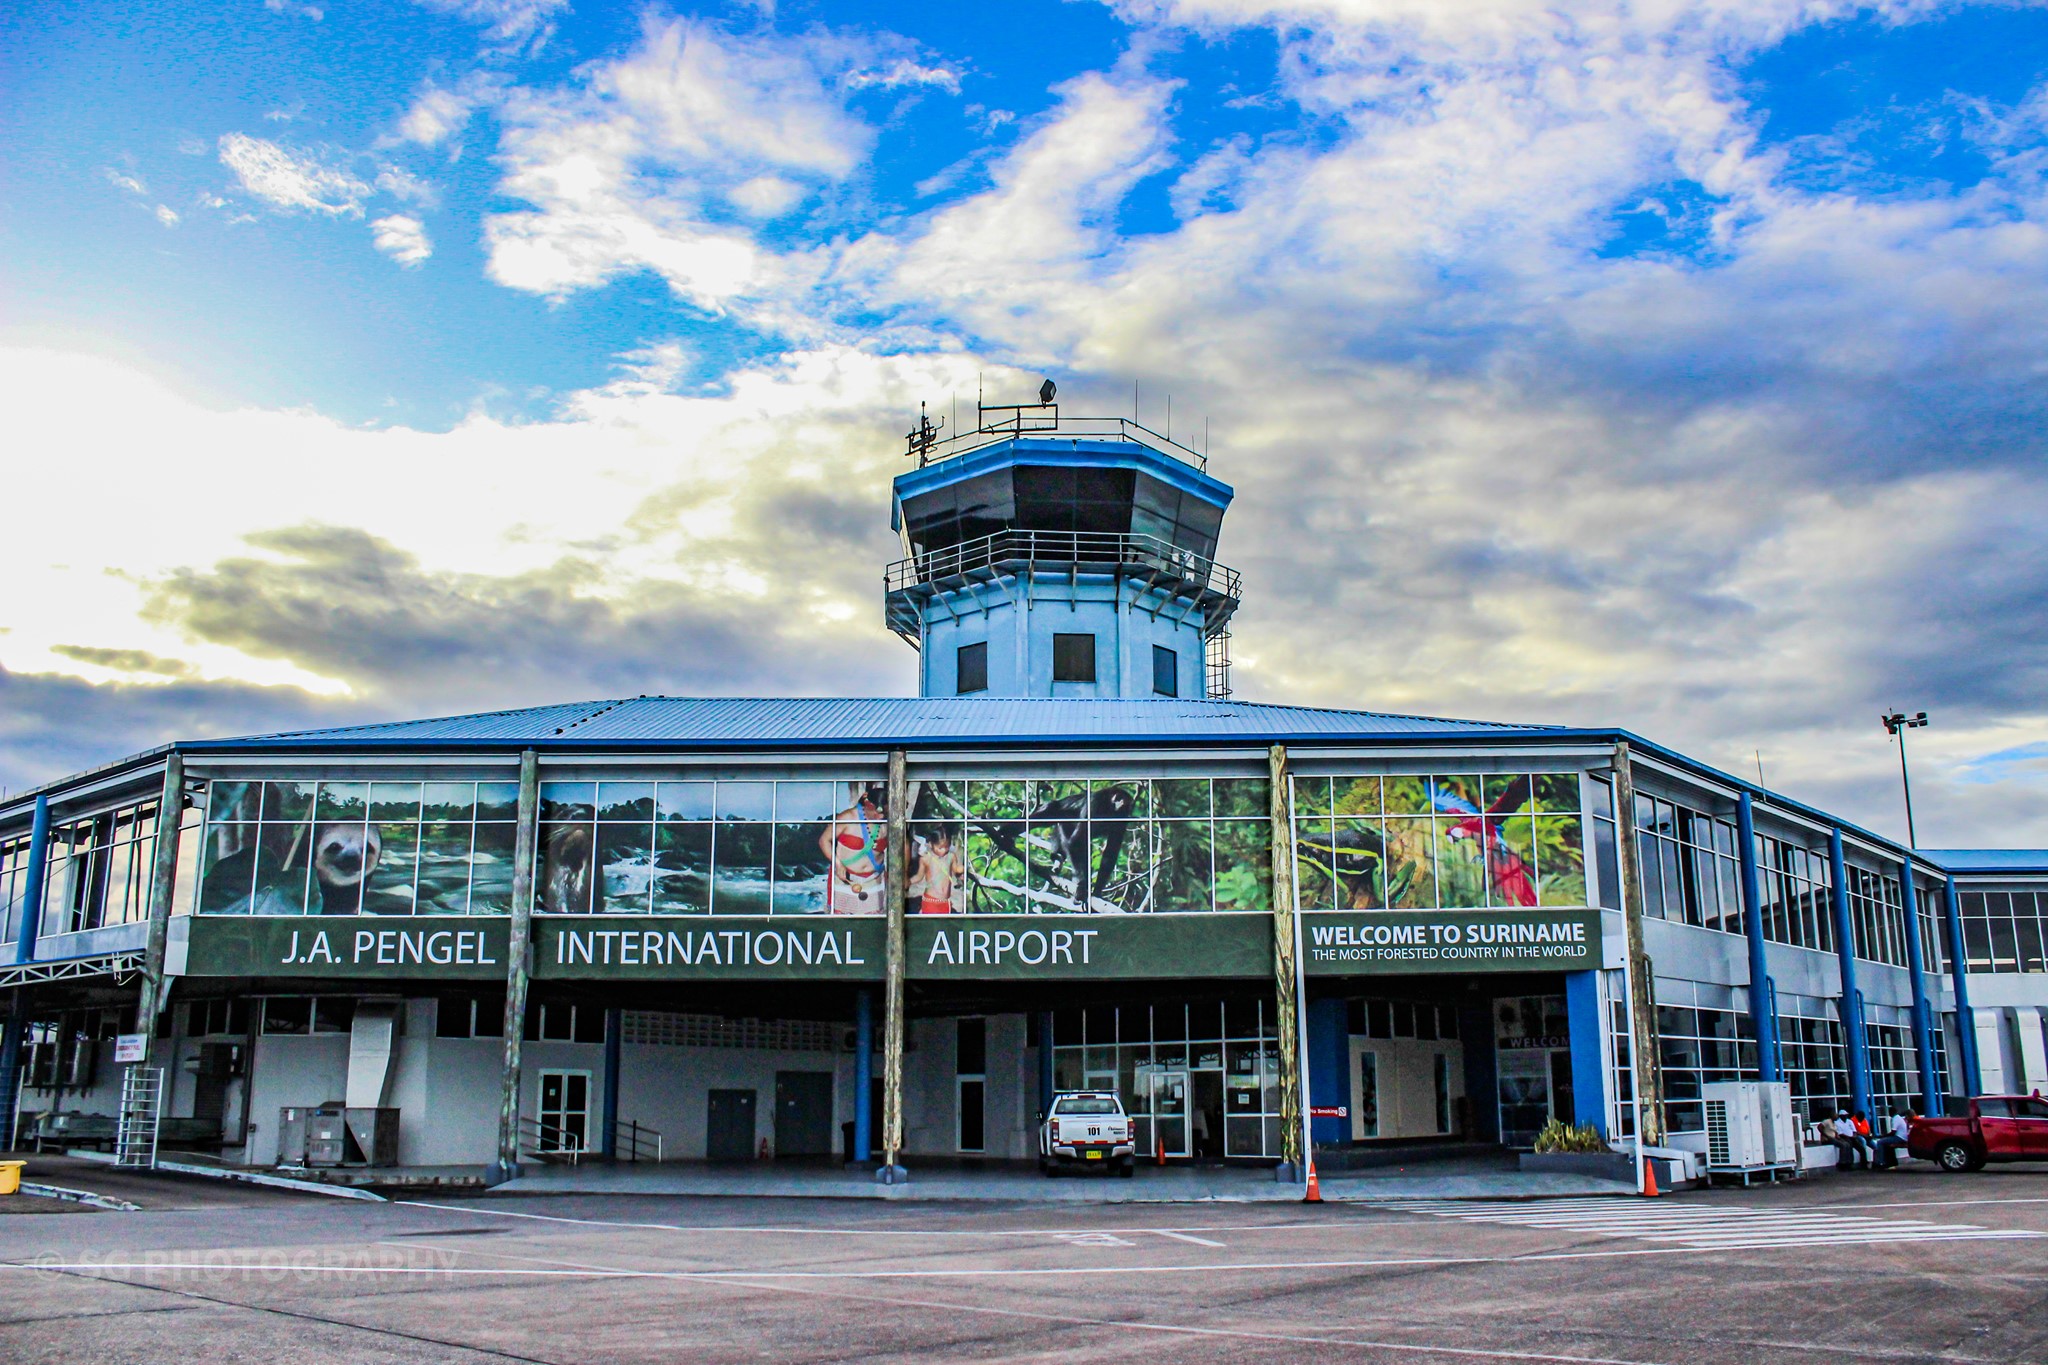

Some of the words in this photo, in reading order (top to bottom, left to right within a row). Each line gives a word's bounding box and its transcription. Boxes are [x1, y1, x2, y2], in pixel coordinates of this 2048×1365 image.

[1311, 925, 1427, 945] WELCOME
[1429, 924, 1461, 944] TO
[1466, 923, 1586, 943] SURINAME
[281, 930, 342, 965] J.A.
[353, 930, 496, 965] PENGEL
[557, 930, 865, 965] INTERNATIONAL
[927, 930, 1099, 965] AIRPORT
[1311, 948, 1336, 961] THE
[1339, 948, 1374, 960] MOST
[1377, 947, 1438, 960] FORESTED
[1441, 946, 1499, 959] COUNTRY
[1502, 946, 1516, 958] IN
[1516, 946, 1540, 958] THE
[1541, 945, 1587, 957] WORLD
[1087, 1126, 1100, 1136] 101
